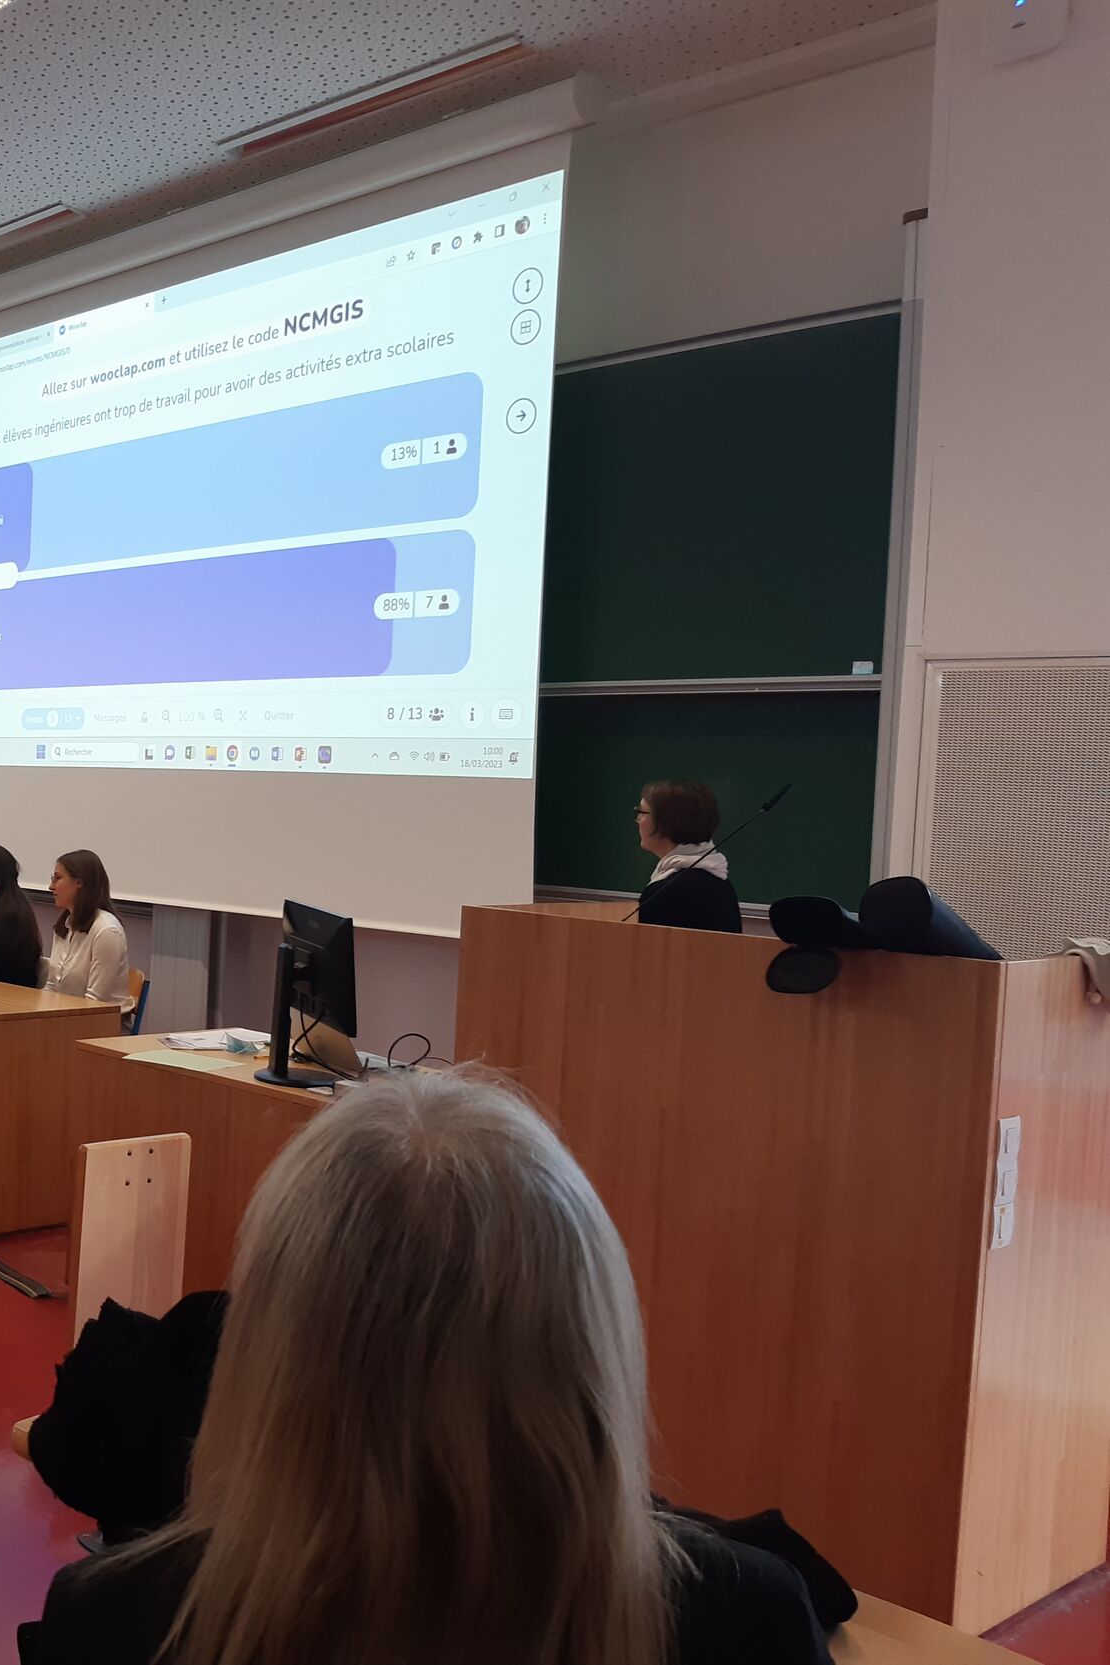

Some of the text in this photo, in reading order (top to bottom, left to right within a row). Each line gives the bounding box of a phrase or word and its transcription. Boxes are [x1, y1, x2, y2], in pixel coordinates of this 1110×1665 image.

[41, 298, 364, 397] Allez sur wooclap.com et utilisez le code NCMGIS
[3, 427, 32, 444] élèves
[35, 414, 91, 438] ingénieures
[94, 408, 112, 423] ont
[114, 404, 136, 419] trop
[139, 398, 153, 413] de
[156, 388, 191, 409] travail
[194, 384, 222, 404] pour
[225, 374, 255, 393] avoir
[259, 370, 282, 386] des
[285, 354, 341, 380] activités
[345, 348, 382, 366] extra
[386, 332, 455, 358] scolaires
[391, 442, 440, 461] 13% 1
[382, 595, 434, 612] 88% 7
[264, 710, 294, 721] Quitter
[387, 707, 395, 720] 8
[408, 707, 423, 720] 13
[483, 747, 503, 756] 10:00
[460, 760, 503, 769] 18/03/2023
